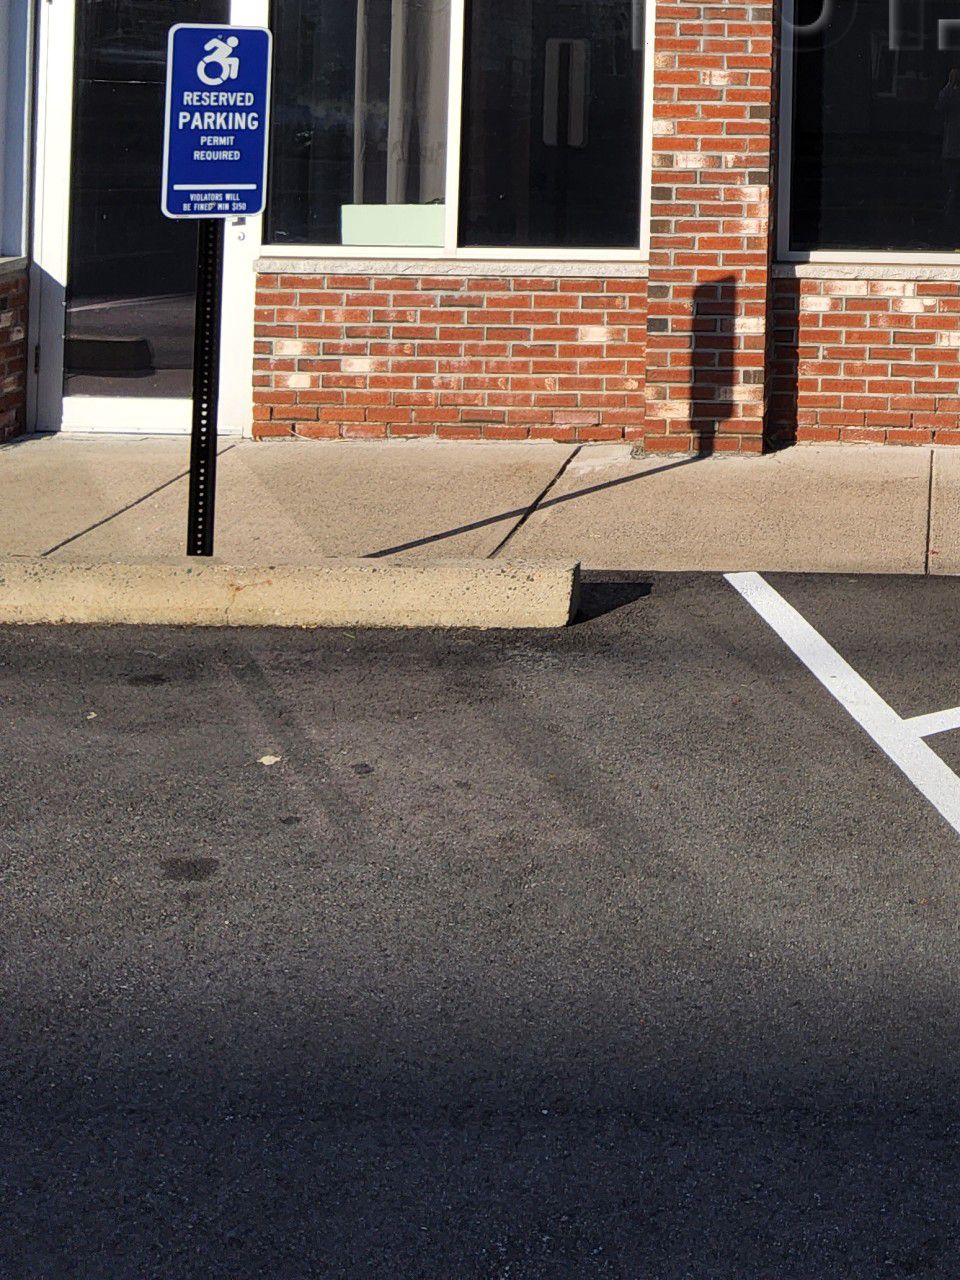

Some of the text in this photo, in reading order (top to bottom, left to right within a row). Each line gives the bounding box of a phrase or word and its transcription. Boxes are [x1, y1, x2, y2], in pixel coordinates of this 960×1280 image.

[183, 91, 254, 106] RESERVED
[178, 111, 259, 130] PARKING
[200, 135, 235, 146] PERMIT
[193, 150, 241, 161] REQUIRED
[190, 193, 240, 201] VIOLATORS WILL
